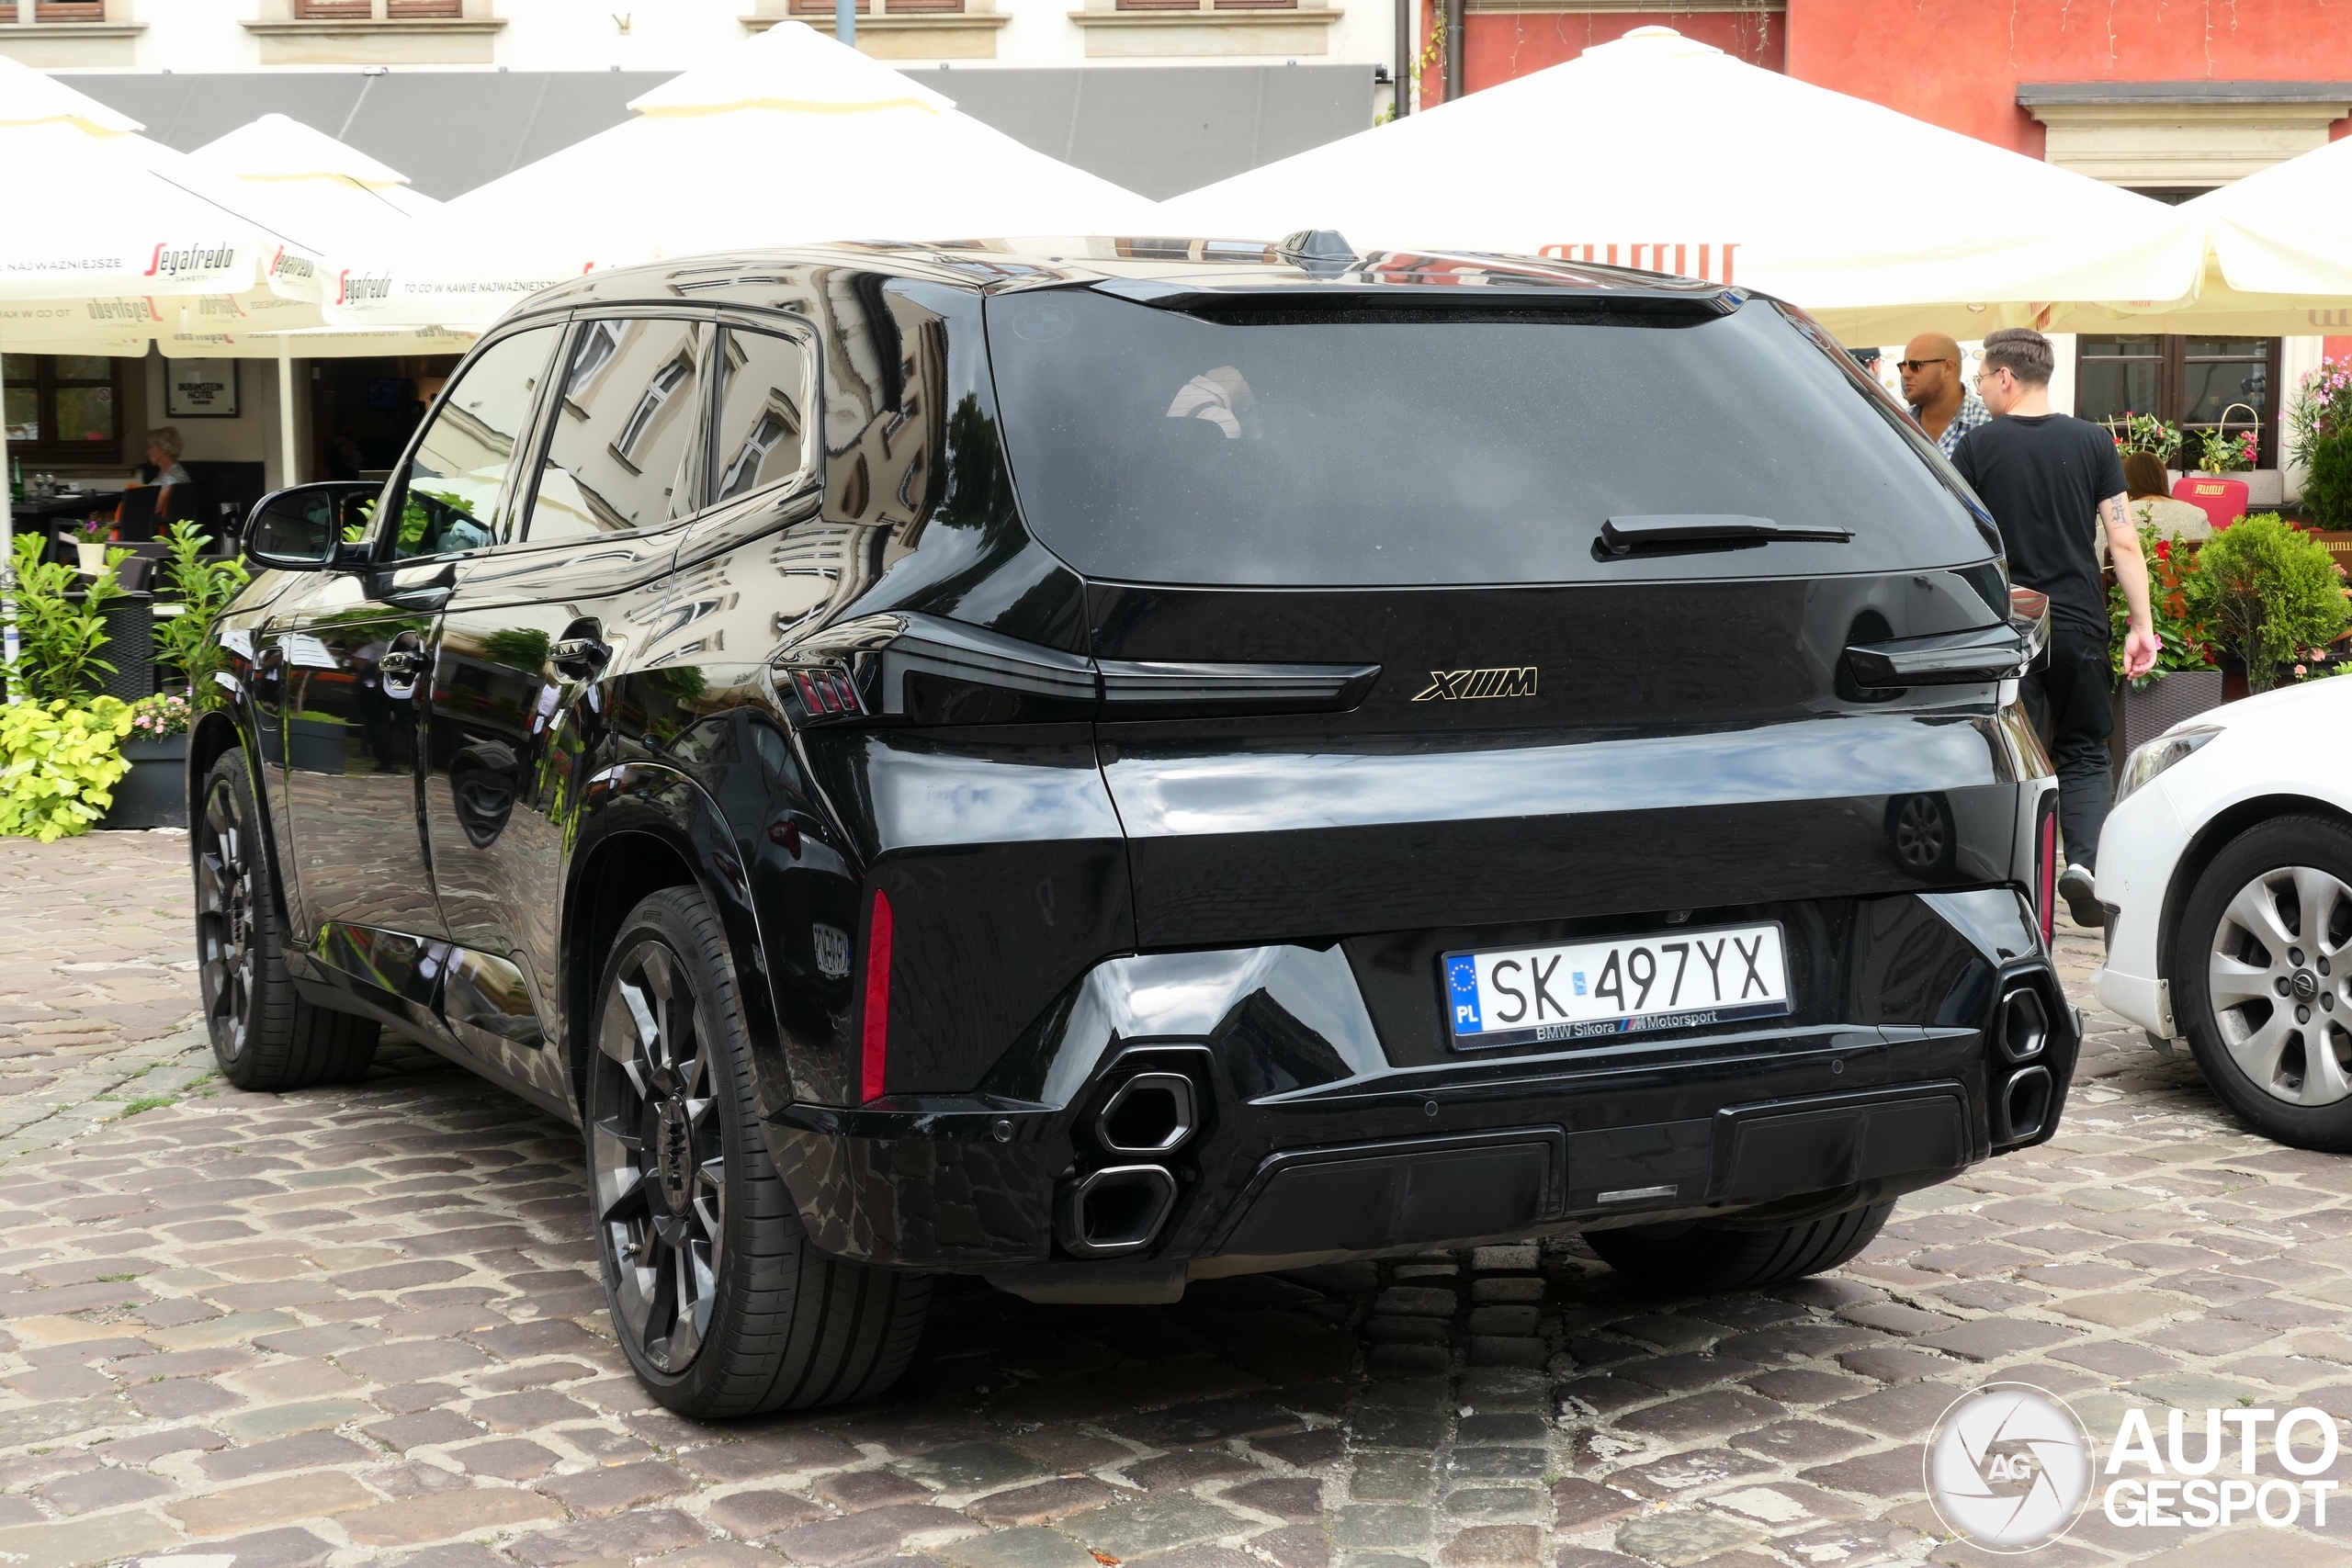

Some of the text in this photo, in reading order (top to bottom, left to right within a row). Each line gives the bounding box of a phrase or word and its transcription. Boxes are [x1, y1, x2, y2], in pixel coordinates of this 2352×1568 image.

[144, 242, 233, 276] Segafredo
[269, 244, 314, 277] Segafredo
[335, 269, 392, 305] Segafredo
[404, 279, 558, 293] TO CO W KAWIE NAJWAŻNIEJS
[177, 382, 223, 391] RUBINSTEIN
[187, 390, 215, 400] HOTEL
[1490, 934, 1770, 1023] SK 497YX
[1456, 1004, 1479, 1024] PL
[1536, 1023, 1571, 1041] BMW
[1574, 1022, 1615, 1037] Sikora
[1646, 1010, 1718, 1030] Motorsport
